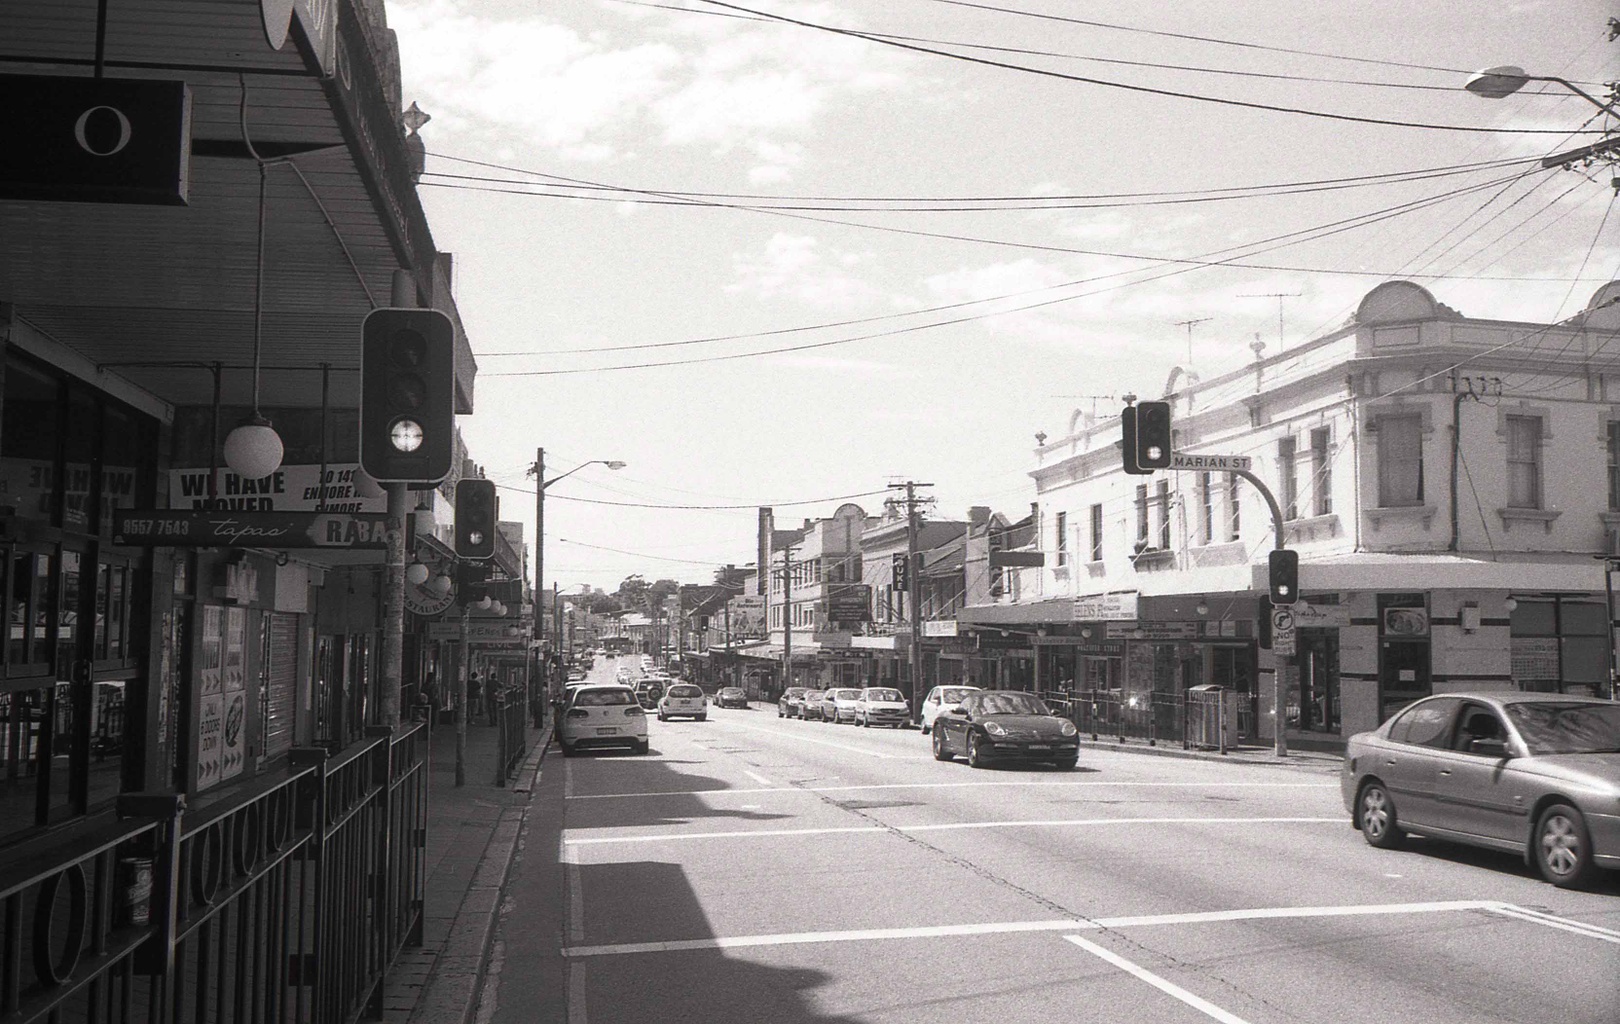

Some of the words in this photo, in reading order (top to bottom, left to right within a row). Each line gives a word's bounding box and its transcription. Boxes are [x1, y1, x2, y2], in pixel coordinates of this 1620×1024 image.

[1174, 457, 1227, 468] MARIAN
[1232, 458, 1248, 468] ST
[225, 472, 285, 495] HAVE
[315, 502, 362, 512] EMORE
[123, 519, 153, 535] 9557
[157, 520, 189, 536] 7543
[209, 518, 290, 545] tapas
[404, 591, 455, 613] STAURANT
